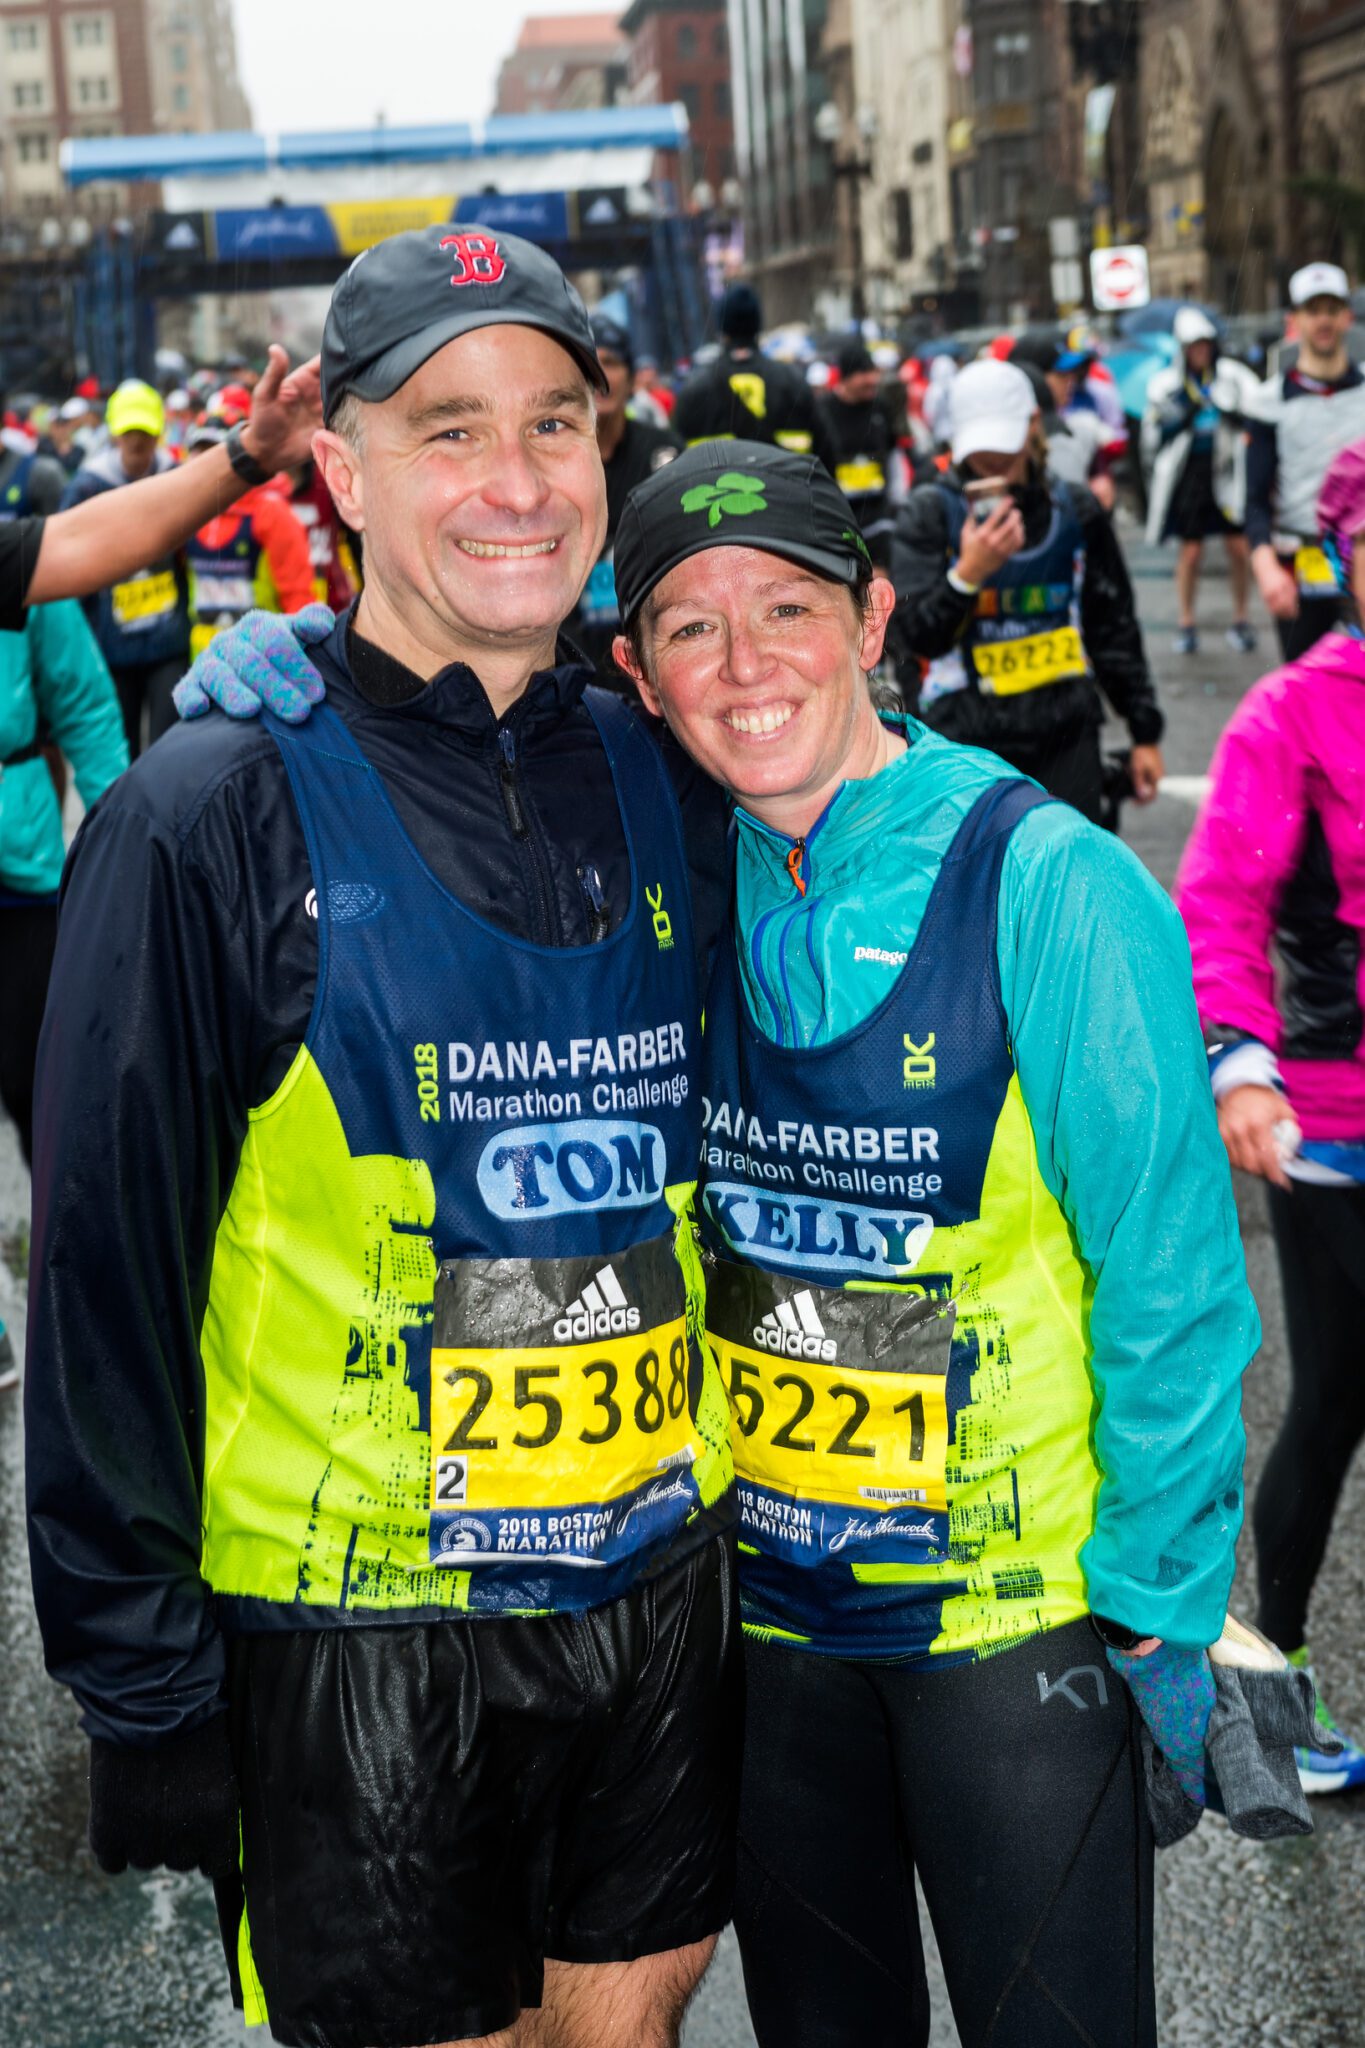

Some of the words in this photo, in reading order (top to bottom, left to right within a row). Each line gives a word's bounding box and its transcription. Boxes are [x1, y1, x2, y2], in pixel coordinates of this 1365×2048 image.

[440, 233, 506, 287] B
[448, 1021, 687, 1083] DANA-FARBER
[414, 1043, 440, 1123] 2018
[450, 1089, 582, 1122] Marathon
[592, 1072, 689, 1112] Challenge
[492, 1133, 660, 1209] TOM
[803, 1162, 942, 1200] Challenge
[706, 1190, 924, 1266] KELLY
[553, 1305, 641, 1344] adidas
[753, 1322, 837, 1360] adidas
[443, 1335, 687, 1452] 25388
[709, 1345, 926, 1461] 5221
[437, 1461, 465, 1500] 2
[498, 1517, 541, 1536] 2018
[551, 1509, 613, 1533] BOSTON
[757, 1495, 811, 1528] BOSTON
[828, 1517, 872, 1554] John
[872, 1515, 940, 1543] Hancock
